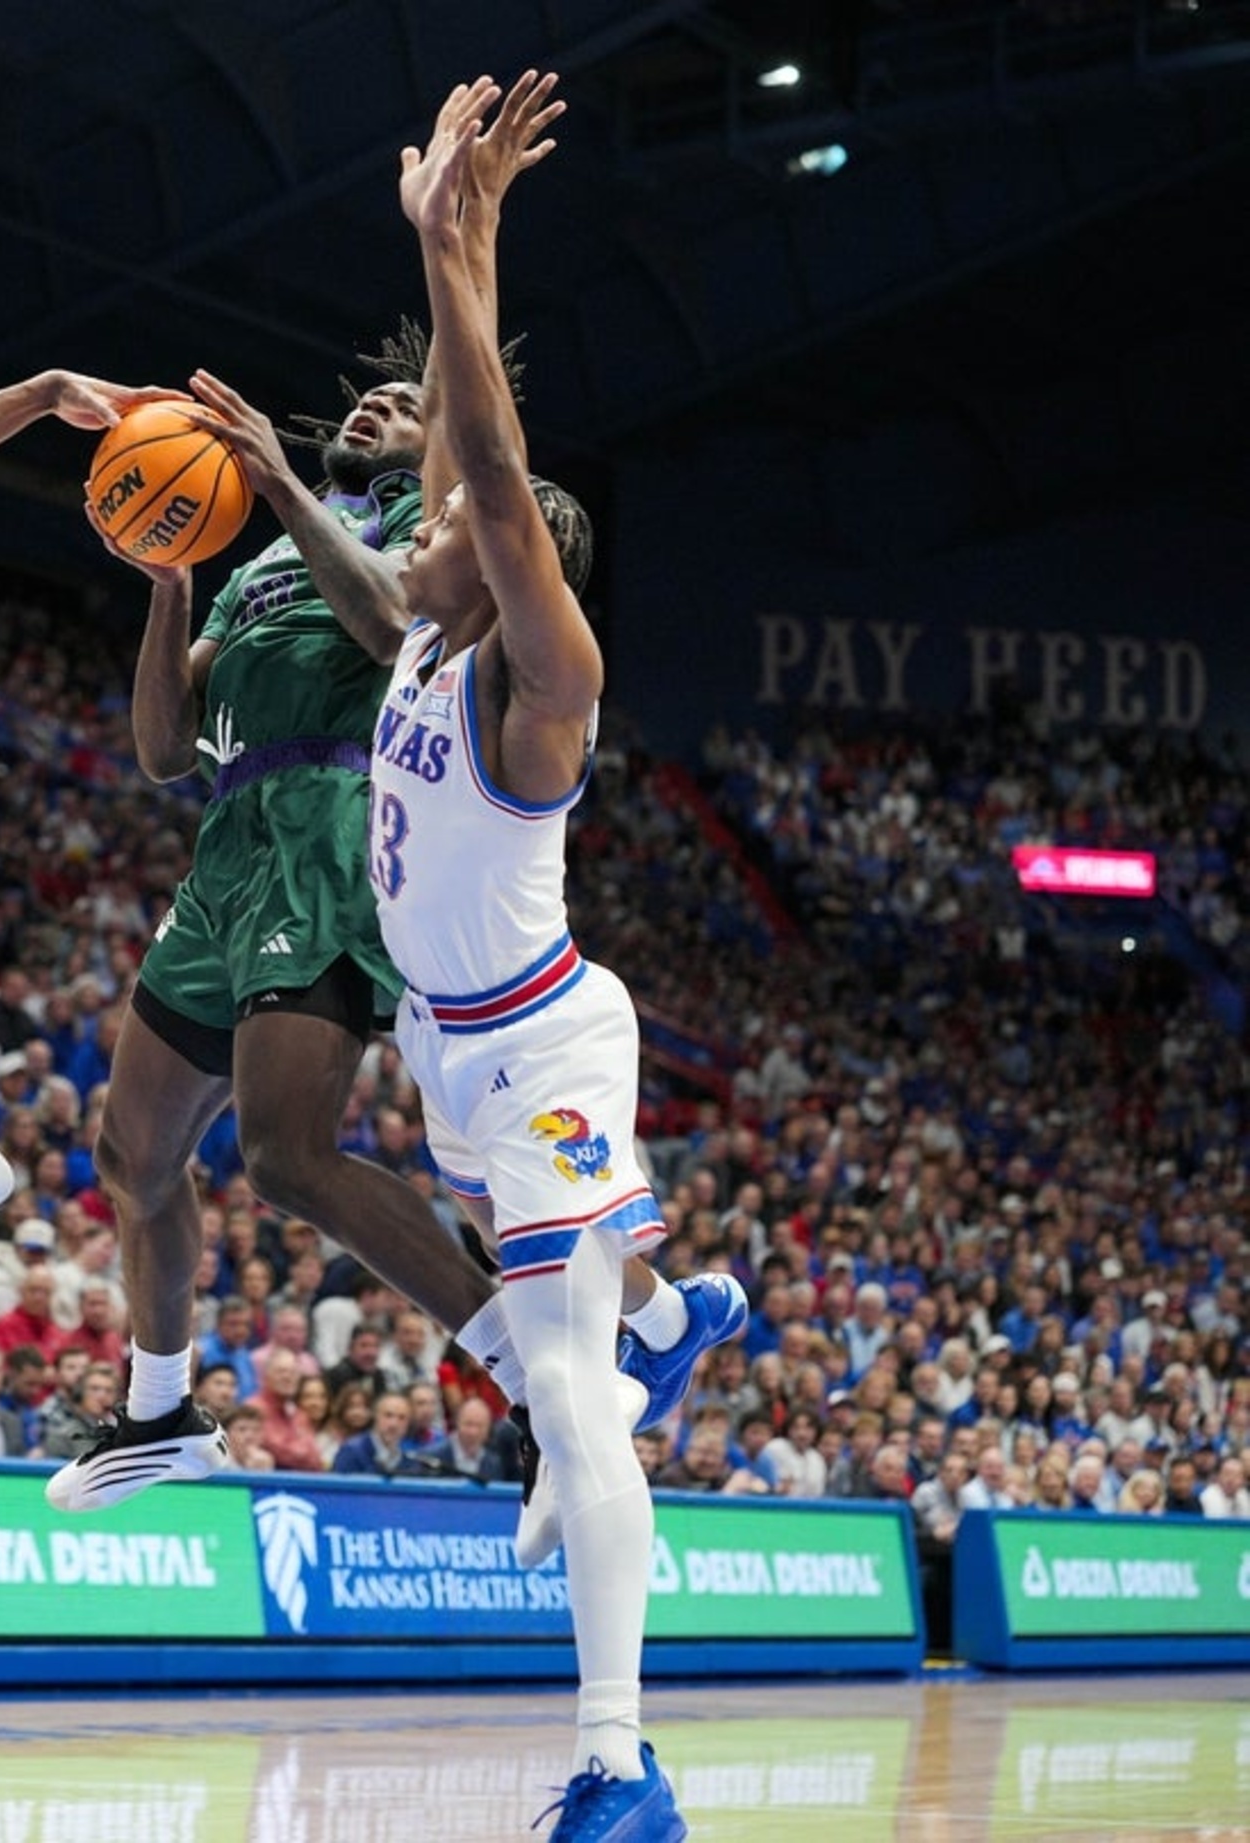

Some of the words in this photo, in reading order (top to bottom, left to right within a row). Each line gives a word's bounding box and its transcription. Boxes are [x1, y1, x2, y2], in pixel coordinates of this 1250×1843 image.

[754, 614, 921, 712] PAY
[966, 626, 1207, 730] HEED
[50, 1531, 216, 1588] DENTAL
[322, 1525, 383, 1569] THE
[382, 1528, 522, 1571] UNIVERSIT
[684, 1548, 773, 1595] DELTA
[773, 1552, 882, 1597] DENTAL
[330, 1567, 432, 1609] KANSAS
[431, 1569, 526, 1610] HEALTH
